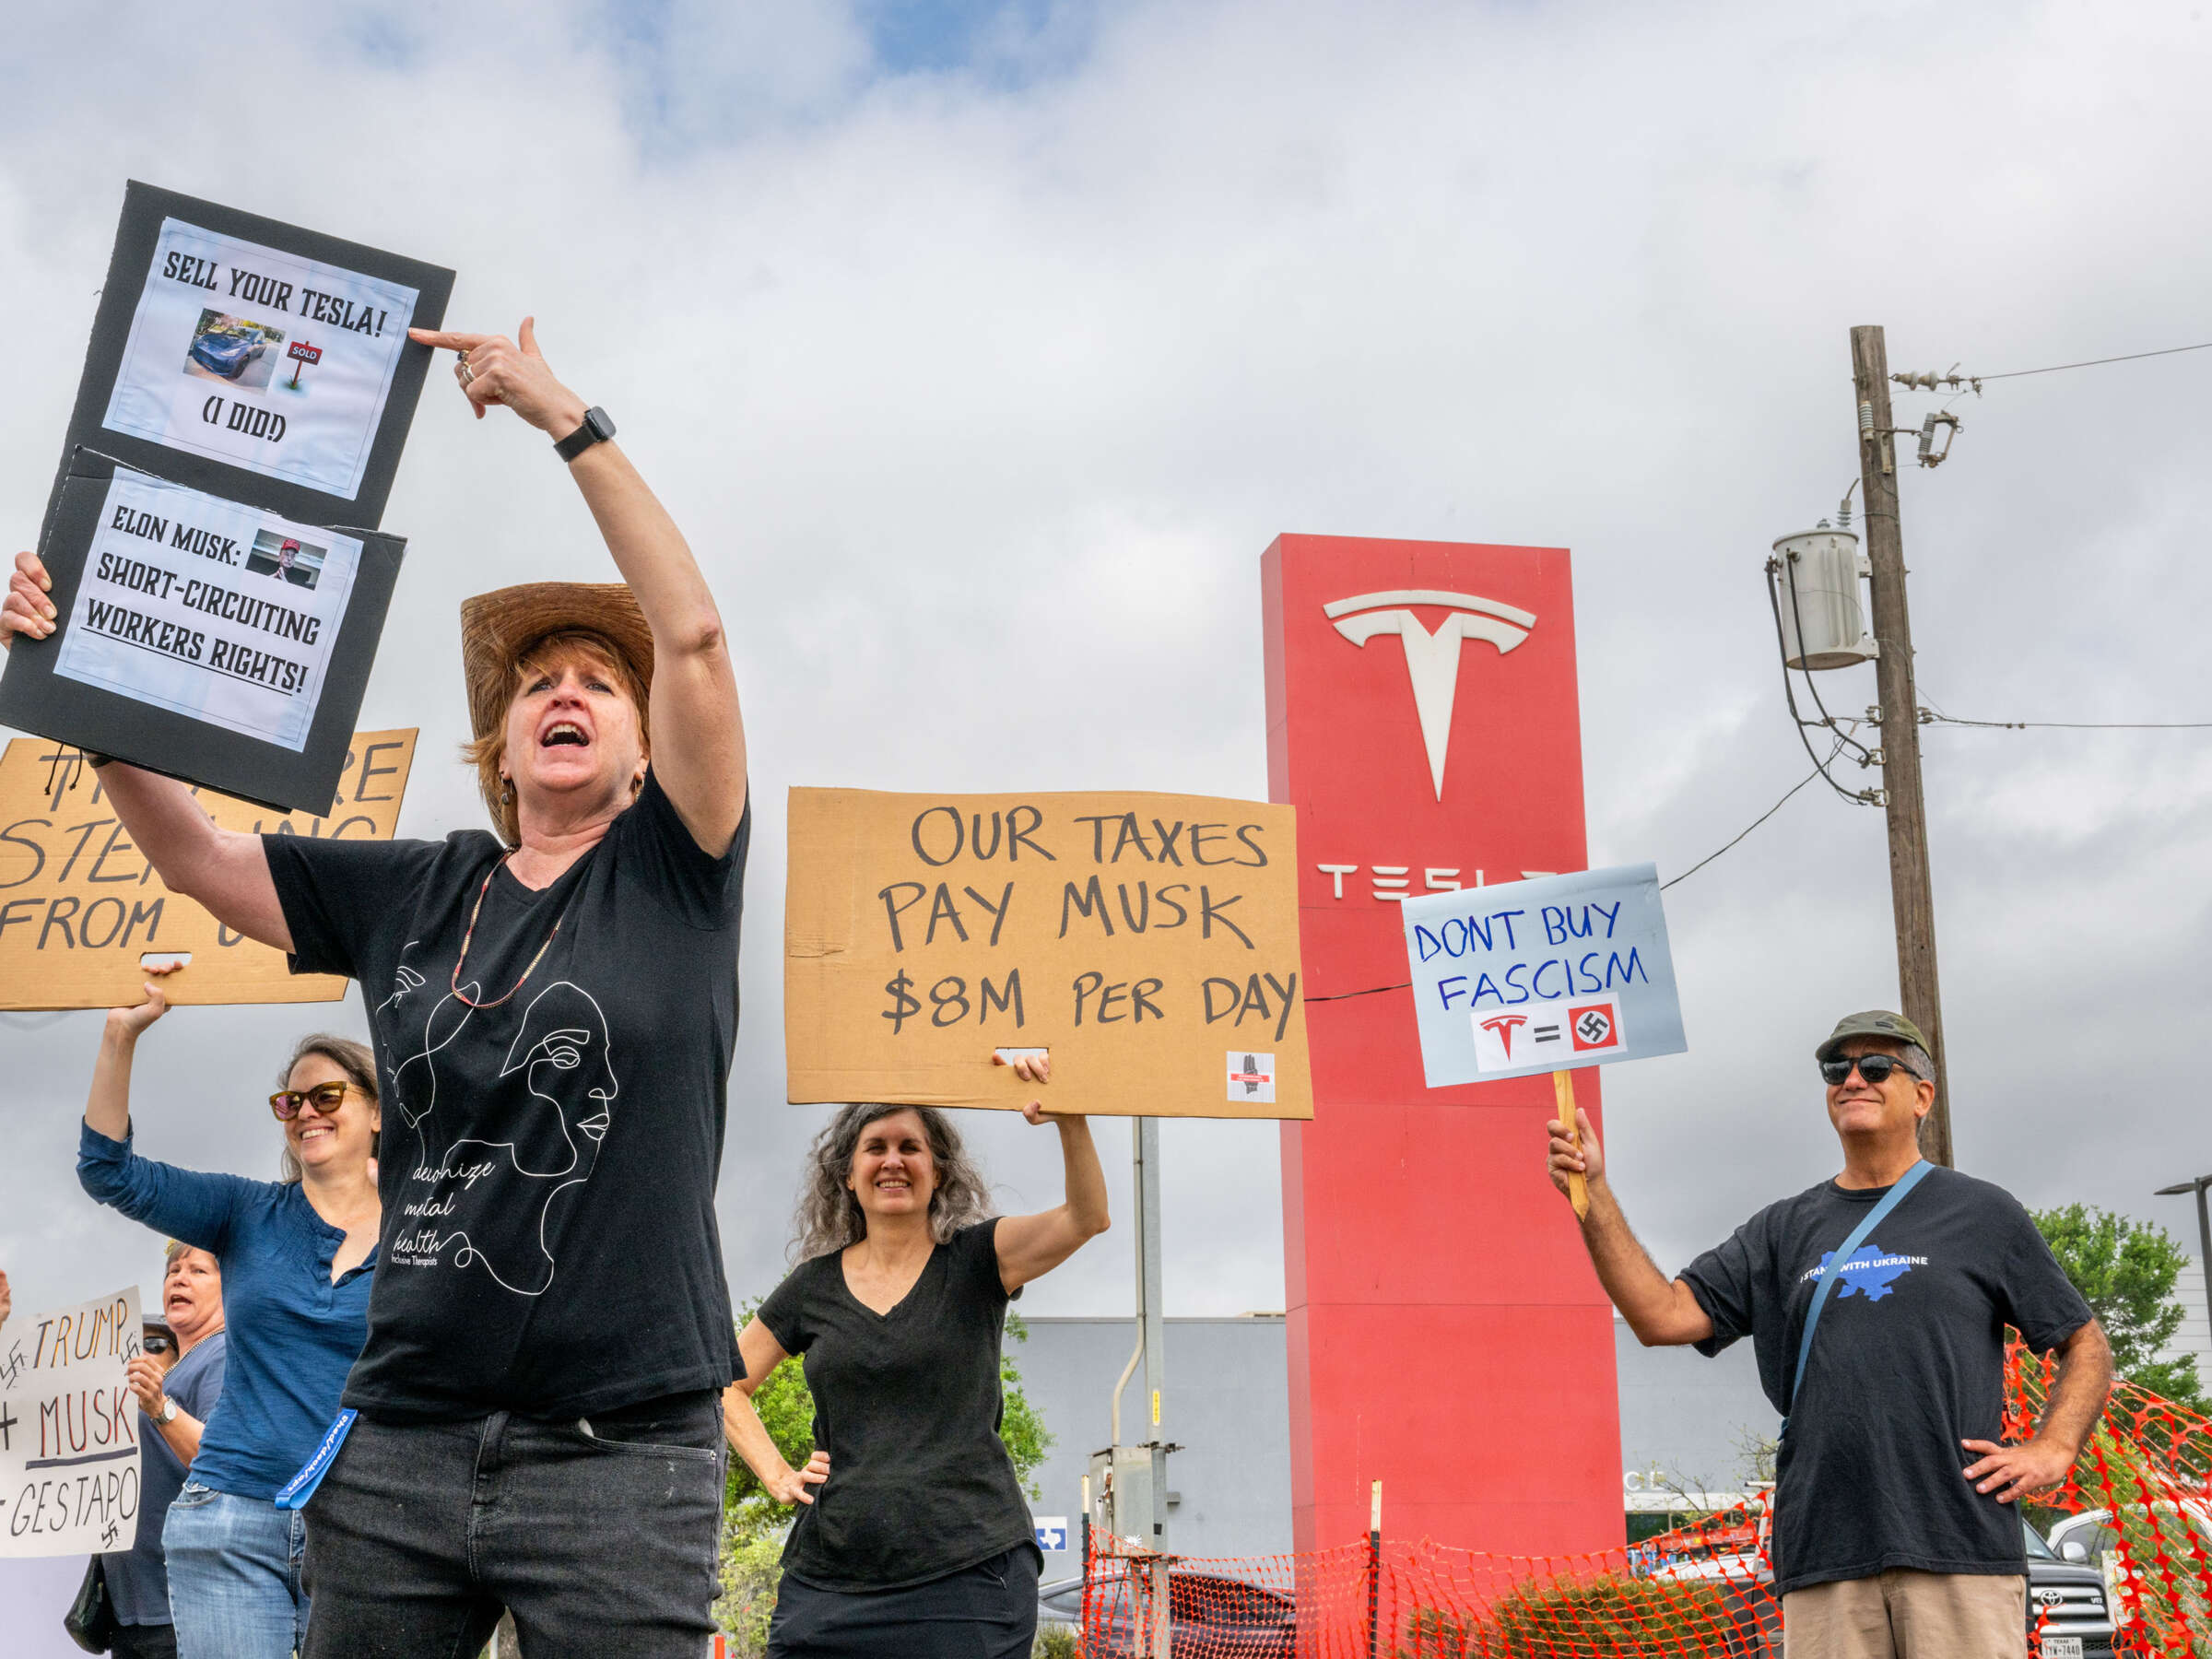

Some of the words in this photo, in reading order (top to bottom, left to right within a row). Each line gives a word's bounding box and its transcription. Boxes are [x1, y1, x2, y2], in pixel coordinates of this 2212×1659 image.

[163, 251, 218, 291] SELL
[229, 269, 292, 312] YOUR
[301, 288, 388, 338] TESLA!
[291, 346, 318, 360] SOLD
[202, 395, 225, 425] (I
[227, 403, 287, 443] DID!)
[111, 505, 169, 543] ELON
[171, 523, 241, 567] MUSK:
[97, 552, 322, 646] SHORT-CIRCUITING
[86, 599, 206, 661] WORKERS
[209, 639, 309, 693] RIGHTS!
[912, 806, 1057, 866] OUR
[1074, 812, 1268, 867] TAXES
[0, 897, 165, 950] FROM
[877, 881, 1013, 953] PAY
[1058, 875, 1254, 949] MUSK
[1415, 910, 1524, 962] DONT
[1541, 901, 1620, 946] BUY
[881, 969, 1025, 1035] $8M
[1074, 971, 1164, 1027] PER
[1201, 972, 1297, 1042] DAY
[1438, 947, 1649, 1010] FASCISM
[1804, 1265, 1829, 1281] STAN
[1840, 1261, 1869, 1273] WITH
[1873, 1256, 1928, 1267] UKRAINE
[33, 1297, 127, 1370] TRUMP
[40, 1386, 135, 1458] MUSK
[11, 1466, 137, 1536] GESTAPO
